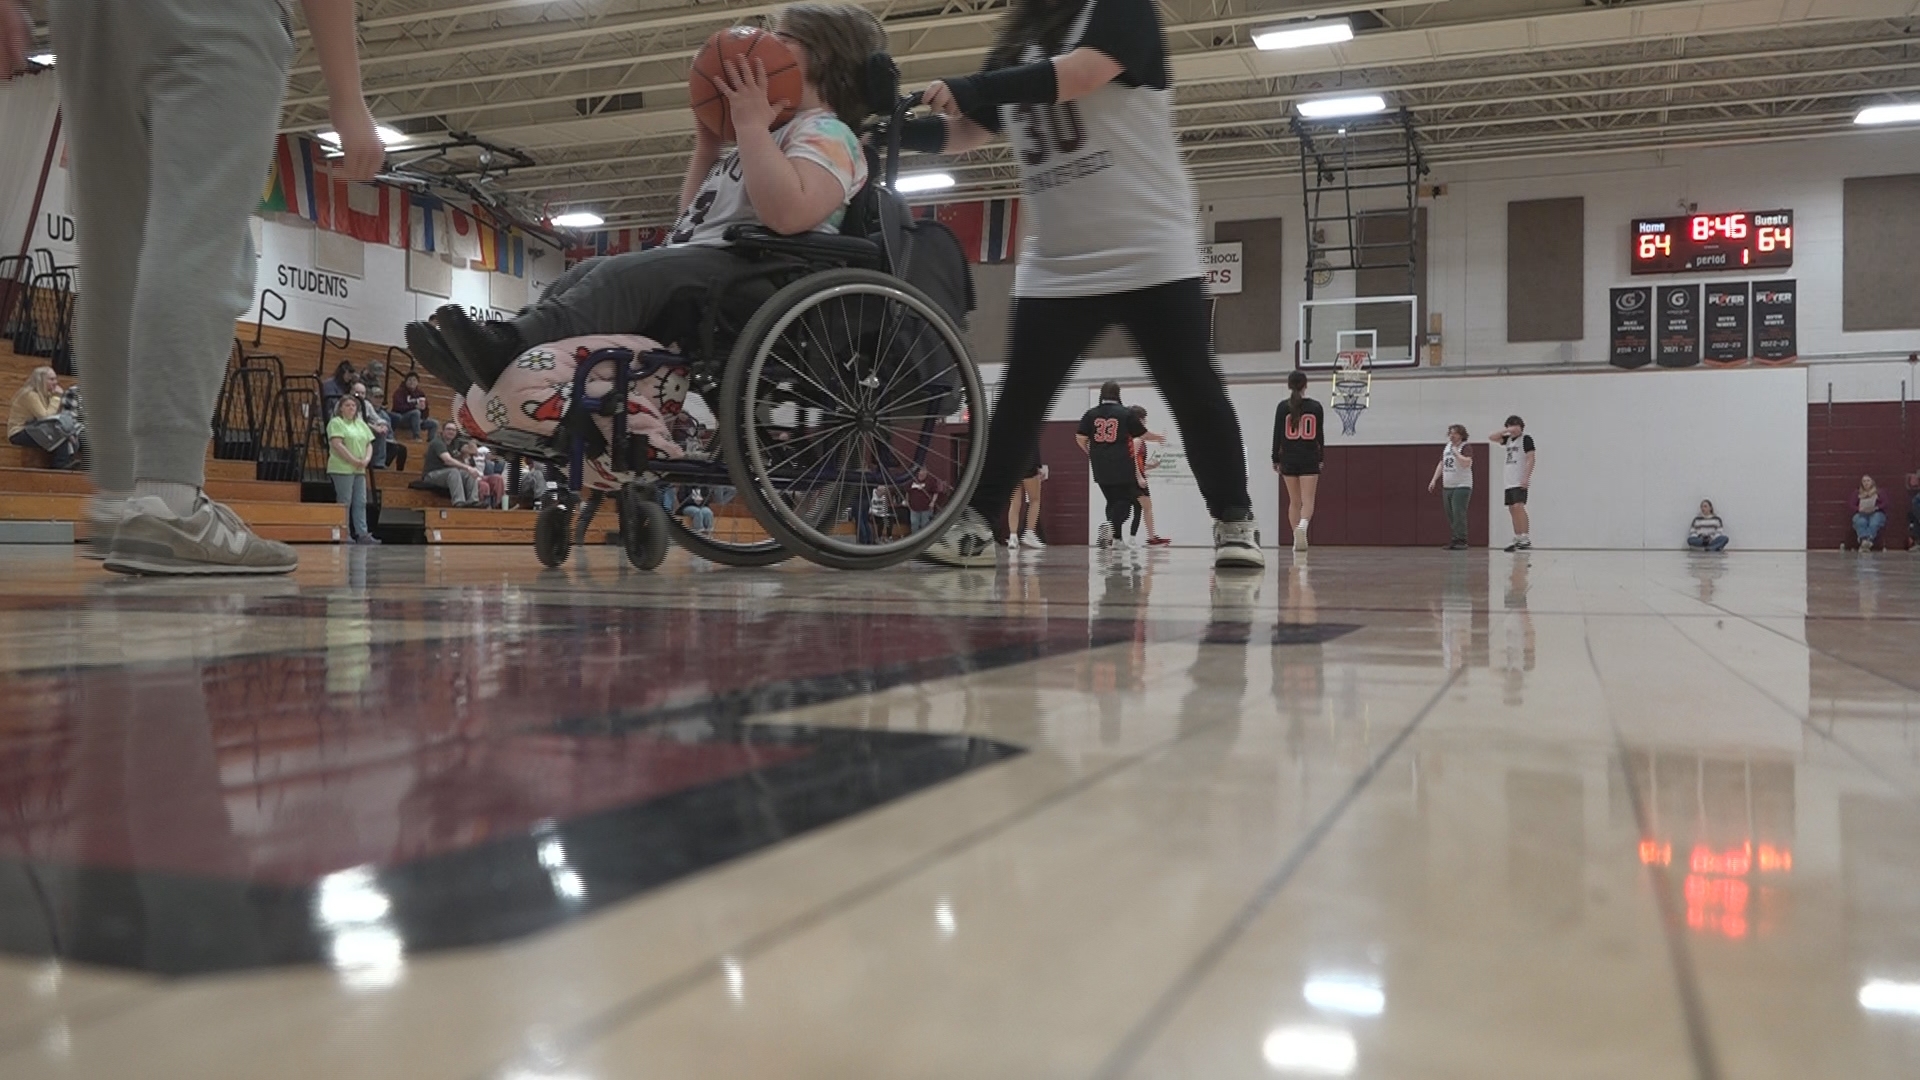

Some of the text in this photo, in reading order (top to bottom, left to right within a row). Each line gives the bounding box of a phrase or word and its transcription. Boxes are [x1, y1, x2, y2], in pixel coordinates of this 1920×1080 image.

[1014, 100, 1087, 166] 30
[1639, 222, 1665, 233] Home
[1754, 215, 1788, 226] Guests
[1640, 234, 1671, 258] 64
[1758, 228, 1791, 251] 64
[1696, 254, 1727, 267] period
[1743, 248, 1749, 265] 1
[277, 264, 349, 299] STUDENTS
[1671, 293, 1685, 306] G
[1094, 418, 1119, 442] 33
[1285, 413, 1317, 440] 00
